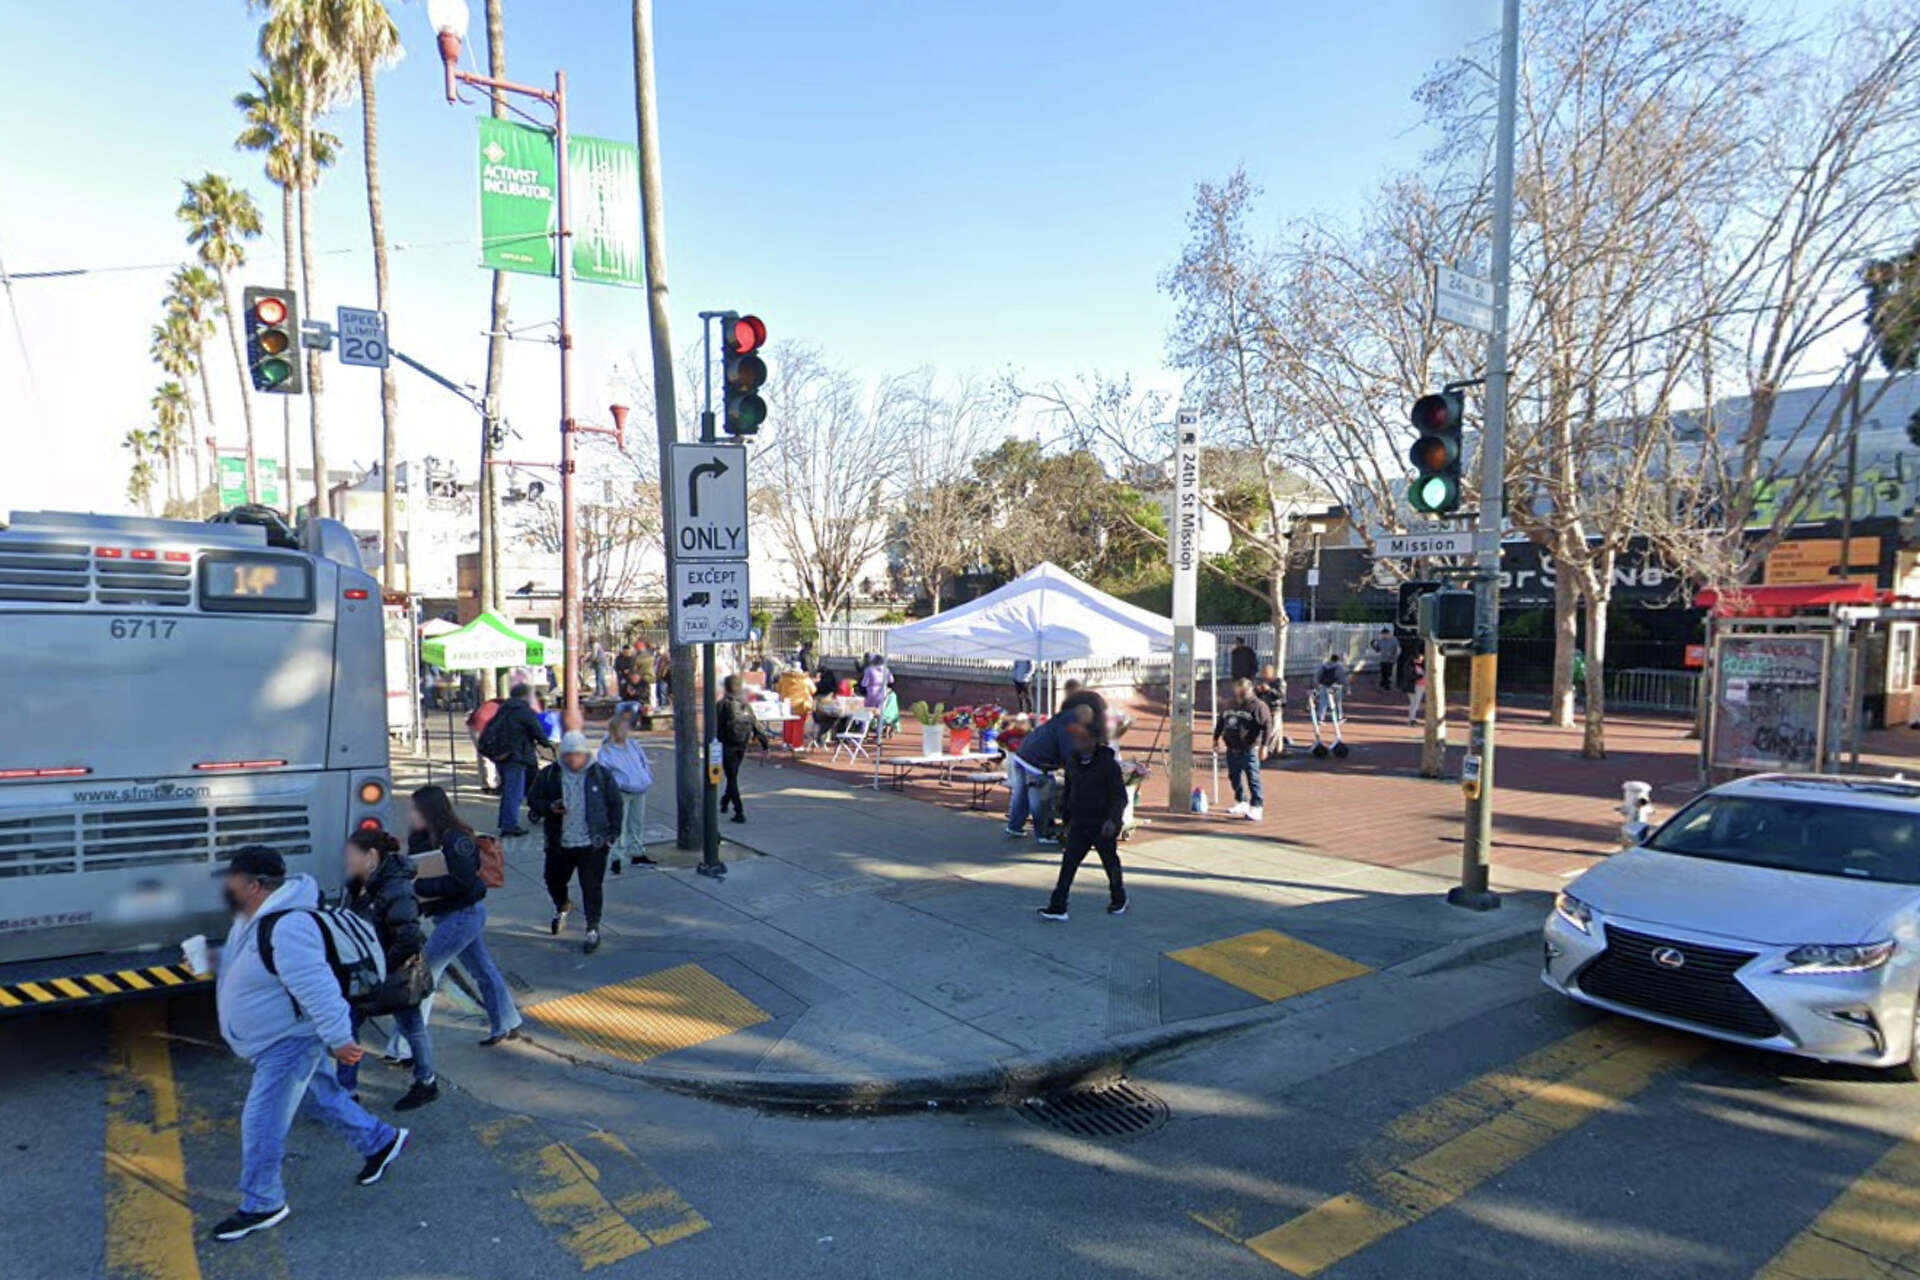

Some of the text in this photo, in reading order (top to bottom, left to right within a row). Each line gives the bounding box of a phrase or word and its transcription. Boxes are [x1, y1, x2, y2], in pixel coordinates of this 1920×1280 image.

[484, 164, 538, 184] ACTIVIST
[343, 313, 382, 326] SPEED
[346, 326, 379, 337] LIMIT
[345, 338, 383, 361] 20
[1182, 453, 1196, 488] 24th
[1182, 493, 1195, 508] St
[680, 526, 741, 551] ONLY
[1180, 513, 1195, 571] Mission
[1391, 538, 1455, 552] Mission
[688, 571, 736, 584] EXCEPT
[110, 619, 177, 639] 6717
[686, 620, 708, 631] TAXI
